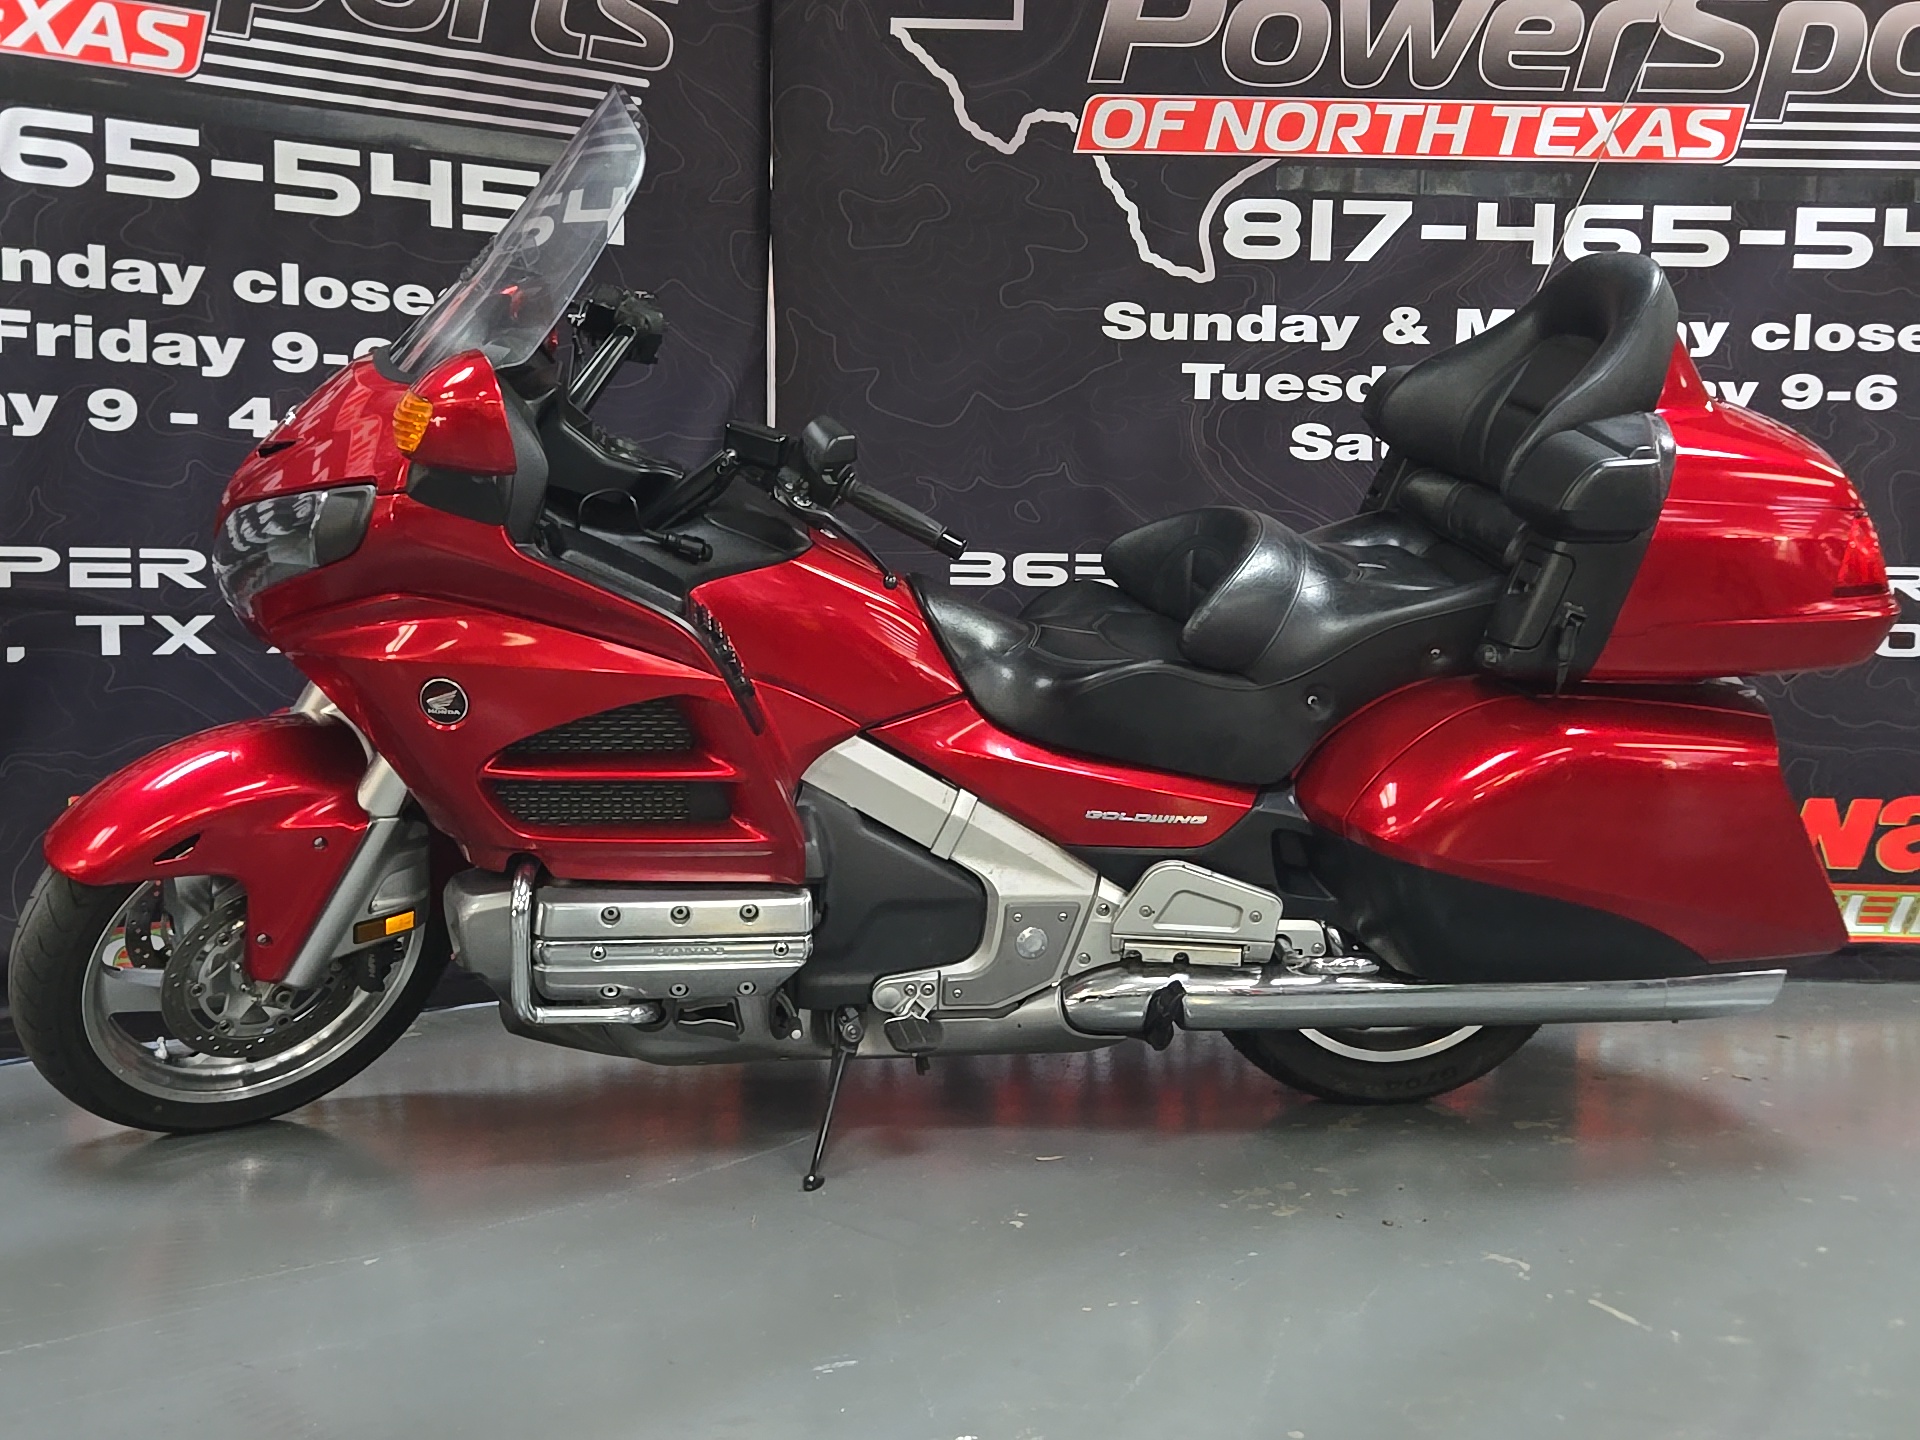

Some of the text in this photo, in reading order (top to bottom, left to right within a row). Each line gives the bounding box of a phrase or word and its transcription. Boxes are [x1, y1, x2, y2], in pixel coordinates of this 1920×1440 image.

[0, 0, 190, 70] XAS
[1091, 99, 1728, 159] OF NORTH TEXAS
[2, 243, 206, 305] nday
[233, 262, 448, 315] close
[1102, 302, 1360, 351] Sunday
[1382, 306, 1431, 345] &
[0, 392, 59, 436] y
[87, 388, 138, 432] 9
[228, 396, 279, 438] 4
[1781, 373, 1898, 411] 9-6
[75, 615, 217, 656] TX
[1085, 809, 1208, 825] GOLDWING
